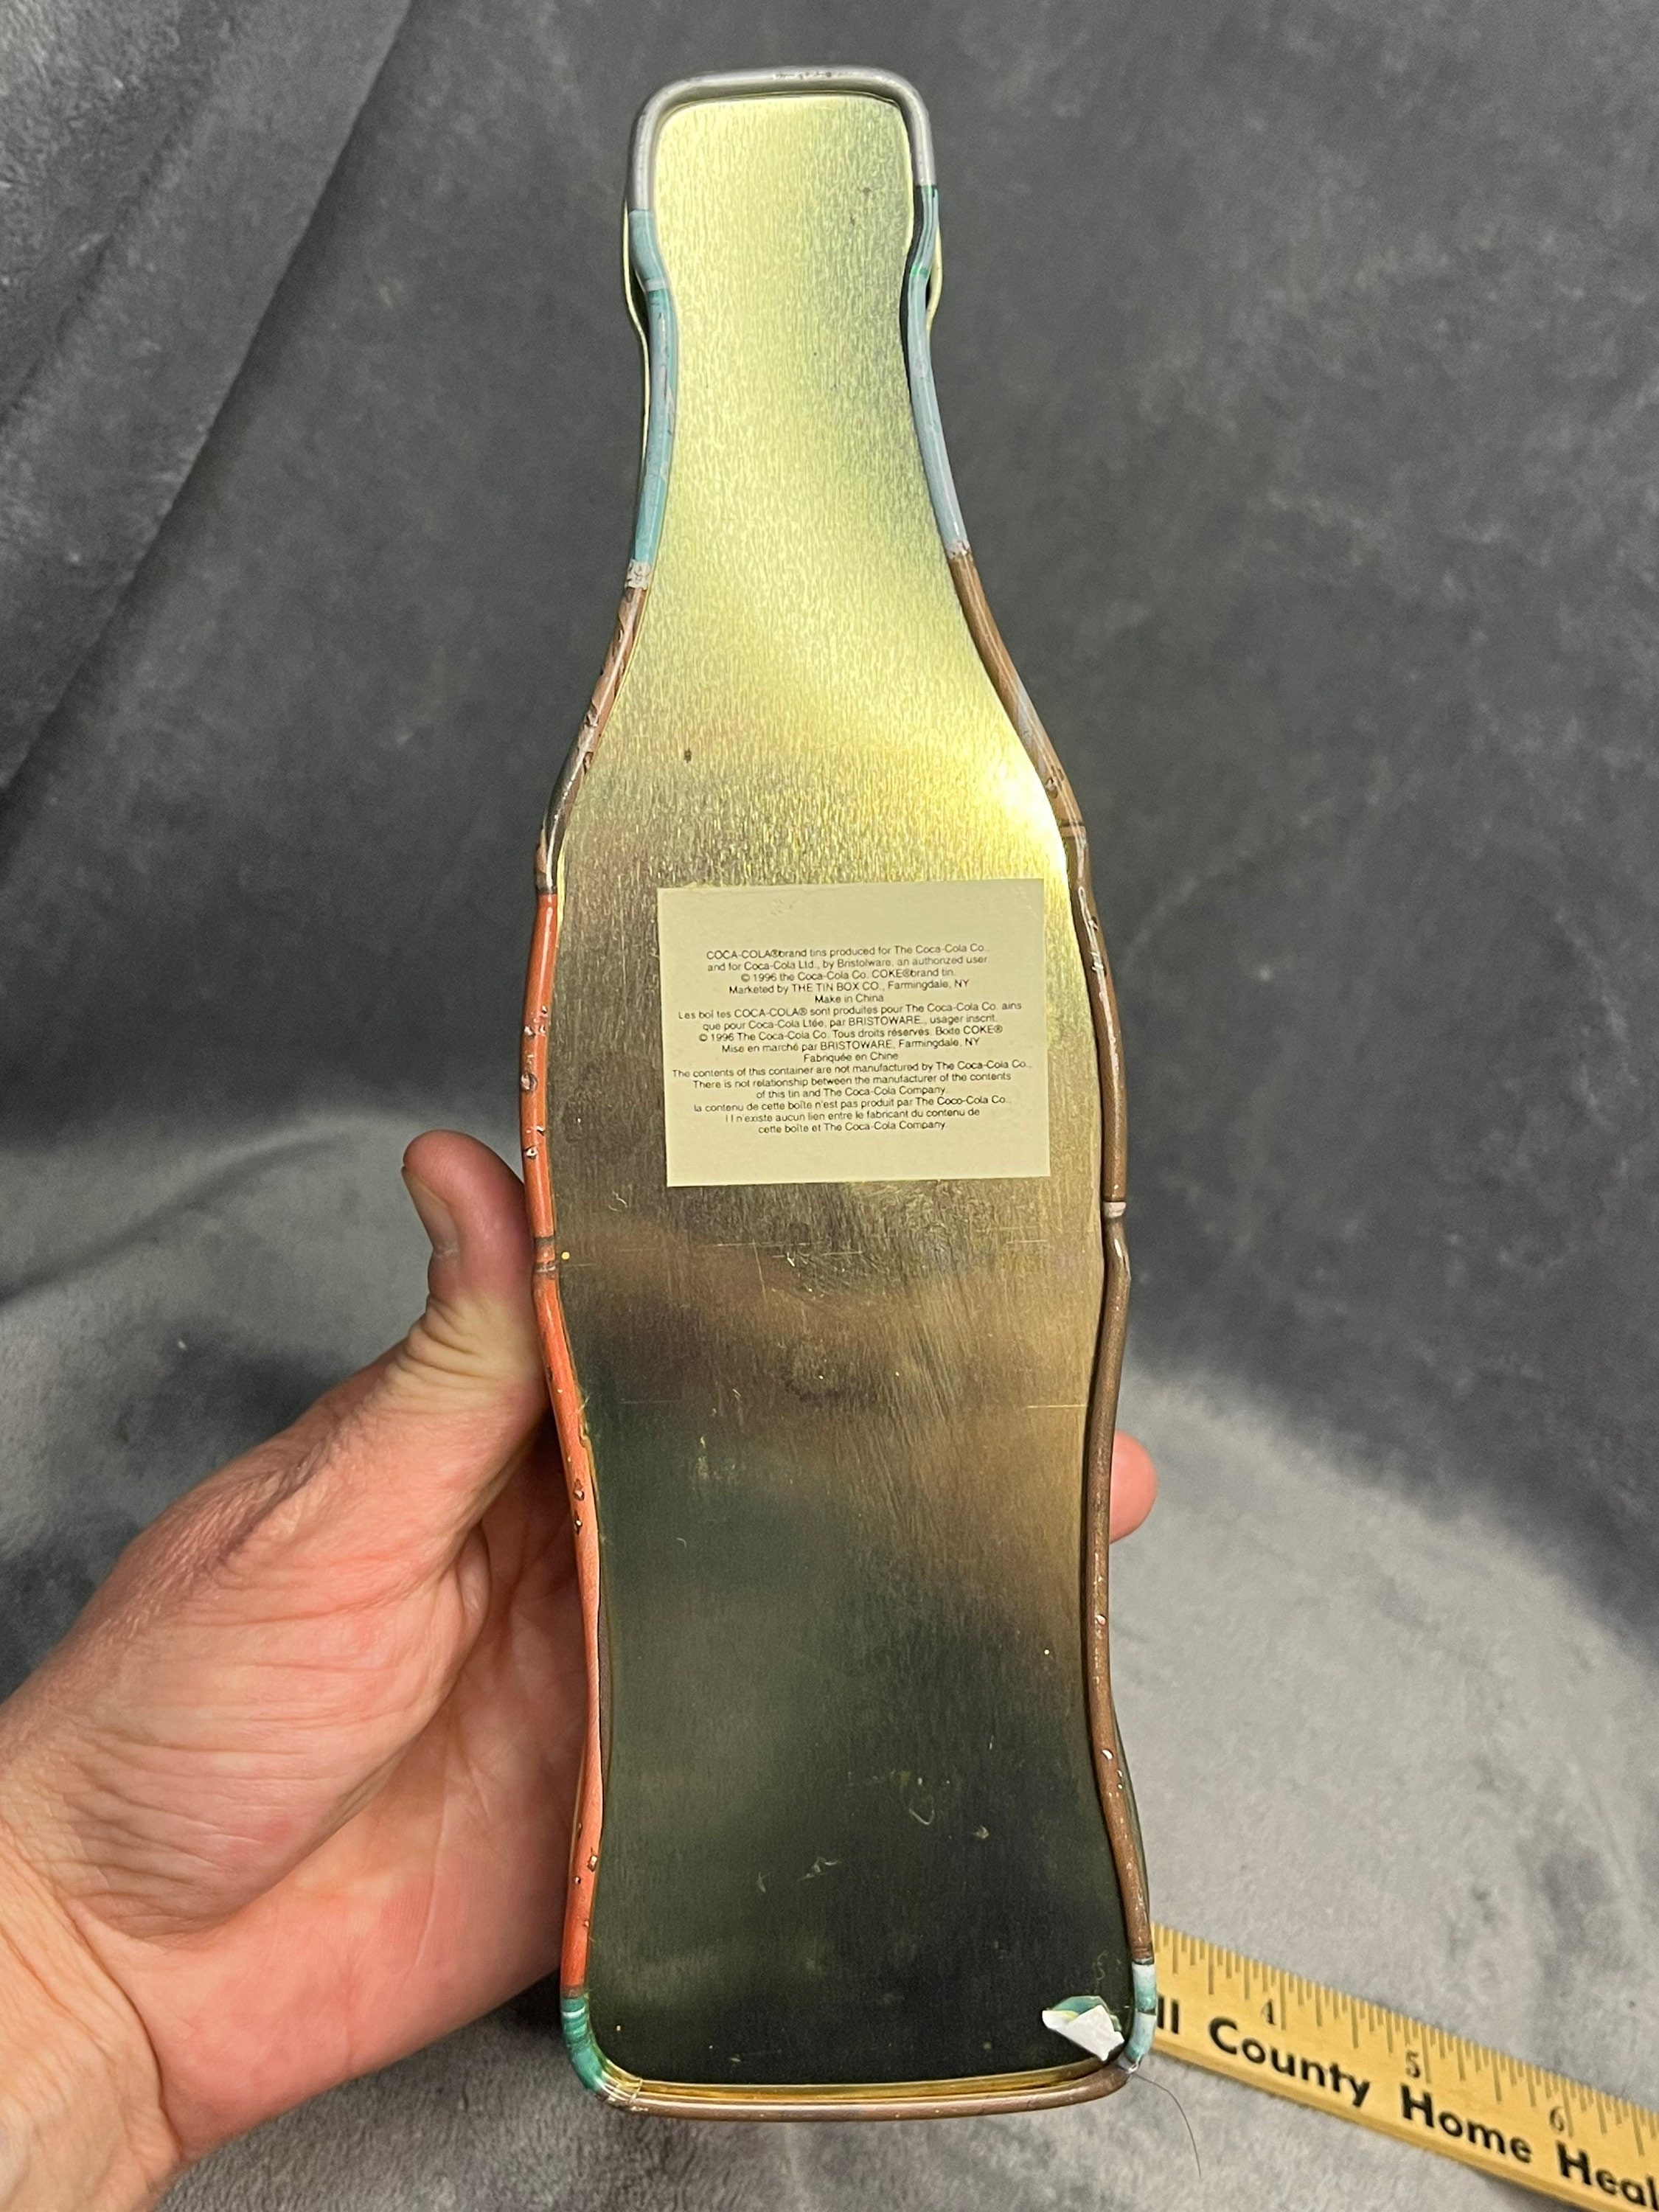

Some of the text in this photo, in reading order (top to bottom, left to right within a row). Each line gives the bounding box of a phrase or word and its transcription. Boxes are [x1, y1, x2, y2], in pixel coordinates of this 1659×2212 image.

[810, 947, 827, 956] tins
[830, 946, 875, 958] produced
[878, 946, 891, 955] for
[894, 945, 912, 954] The
[916, 944, 967, 953] Coca-Cola
[708, 962, 725, 971] and
[728, 962, 741, 970] for
[744, 961, 795, 970] Coca-Cola
[823, 959, 834, 970] by
[913, 956, 963, 965] authorized
[754, 973, 776, 981] 1996
[780, 973, 794, 981] the
[798, 971, 849, 981] Coca-Cola
[729, 984, 774, 994] Marketed
[777, 984, 788, 995] by
[792, 983, 812, 992] THE
[816, 982, 833, 992] TIN
[837, 981, 859, 991] BOX
[955, 978, 970, 987] NY
[815, 993, 884, 1004] Make in China
[678, 1011, 695, 1019] Les
[810, 1007, 830, 1015] sont
[833, 1005, 877, 1017] produites
[881, 1006, 903, 1015] pour
[905, 1004, 924, 1012] The
[927, 1002, 978, 1012] Coca-Cola
[1002, 1002, 1022, 1010] ains
[703, 1023, 720, 1032] que
[724, 1023, 745, 1032] pour
[748, 1019, 799, 1029] Coca-Cola
[830, 1020, 844, 1029] par
[930, 1016, 963, 1025] usager
[712, 1032, 734, 1041] 1996
[737, 1032, 755, 1040] The
[759, 1031, 810, 1040] Coca-Cola
[832, 1029, 855, 1038] Tous
[858, 1029, 885, 1037] droits
[722, 1044, 744, 1052] Mise
[762, 1042, 799, 1051] marché
[802, 1044, 817, 1053] par
[965, 1037, 980, 1046] NY
[804, 1052, 852, 1063] Fabriquée
[870, 1051, 898, 1060] Chine
[672, 1069, 690, 1077] The
[693, 1068, 734, 1077] contents
[737, 1067, 745, 1076] of
[749, 1067, 765, 1076] this
[769, 1065, 813, 1075] container
[835, 1065, 849, 1073] not
[853, 1062, 919, 1072] manufactured
[922, 1062, 933, 1073] by
[936, 1061, 954, 1070] The
[957, 1060, 1009, 1070] Coca-Cola
[693, 1072, 1011, 1088] There is not relationship between the manufacturer of the contents
[757, 1090, 765, 1099] of
[788, 1089, 800, 1098] tin
[803, 1088, 821, 1097] and
[824, 1088, 842, 1096] The
[845, 1086, 896, 1096] Coca-Cola
[705, 1104, 743, 1112] contenu
[746, 1102, 759, 1110] de
[762, 1102, 785, 1110] cette
[841, 1101, 858, 1110] pas
[861, 1098, 894, 1109] produit
[897, 1099, 912, 1108] par
[916, 1097, 933, 1105] The
[808, 1112, 824, 1121] lien
[828, 1111, 852, 1120] entre
[855, 1110, 863, 1119] le
[867, 1109, 908, 1119] fabricant
[911, 1109, 923, 1117] du
[926, 1108, 965, 1117] contenu
[967, 1107, 980, 1116] de
[759, 1125, 782, 1133] cette
[812, 1124, 821, 1132] et
[824, 1122, 842, 1131] The
[845, 1121, 896, 1131] Coca-Cola
[1261, 1998, 1566, 2132] 4 5 6
[1208, 2016, 1371, 2108] County
[1400, 2084, 1534, 2165] Home
